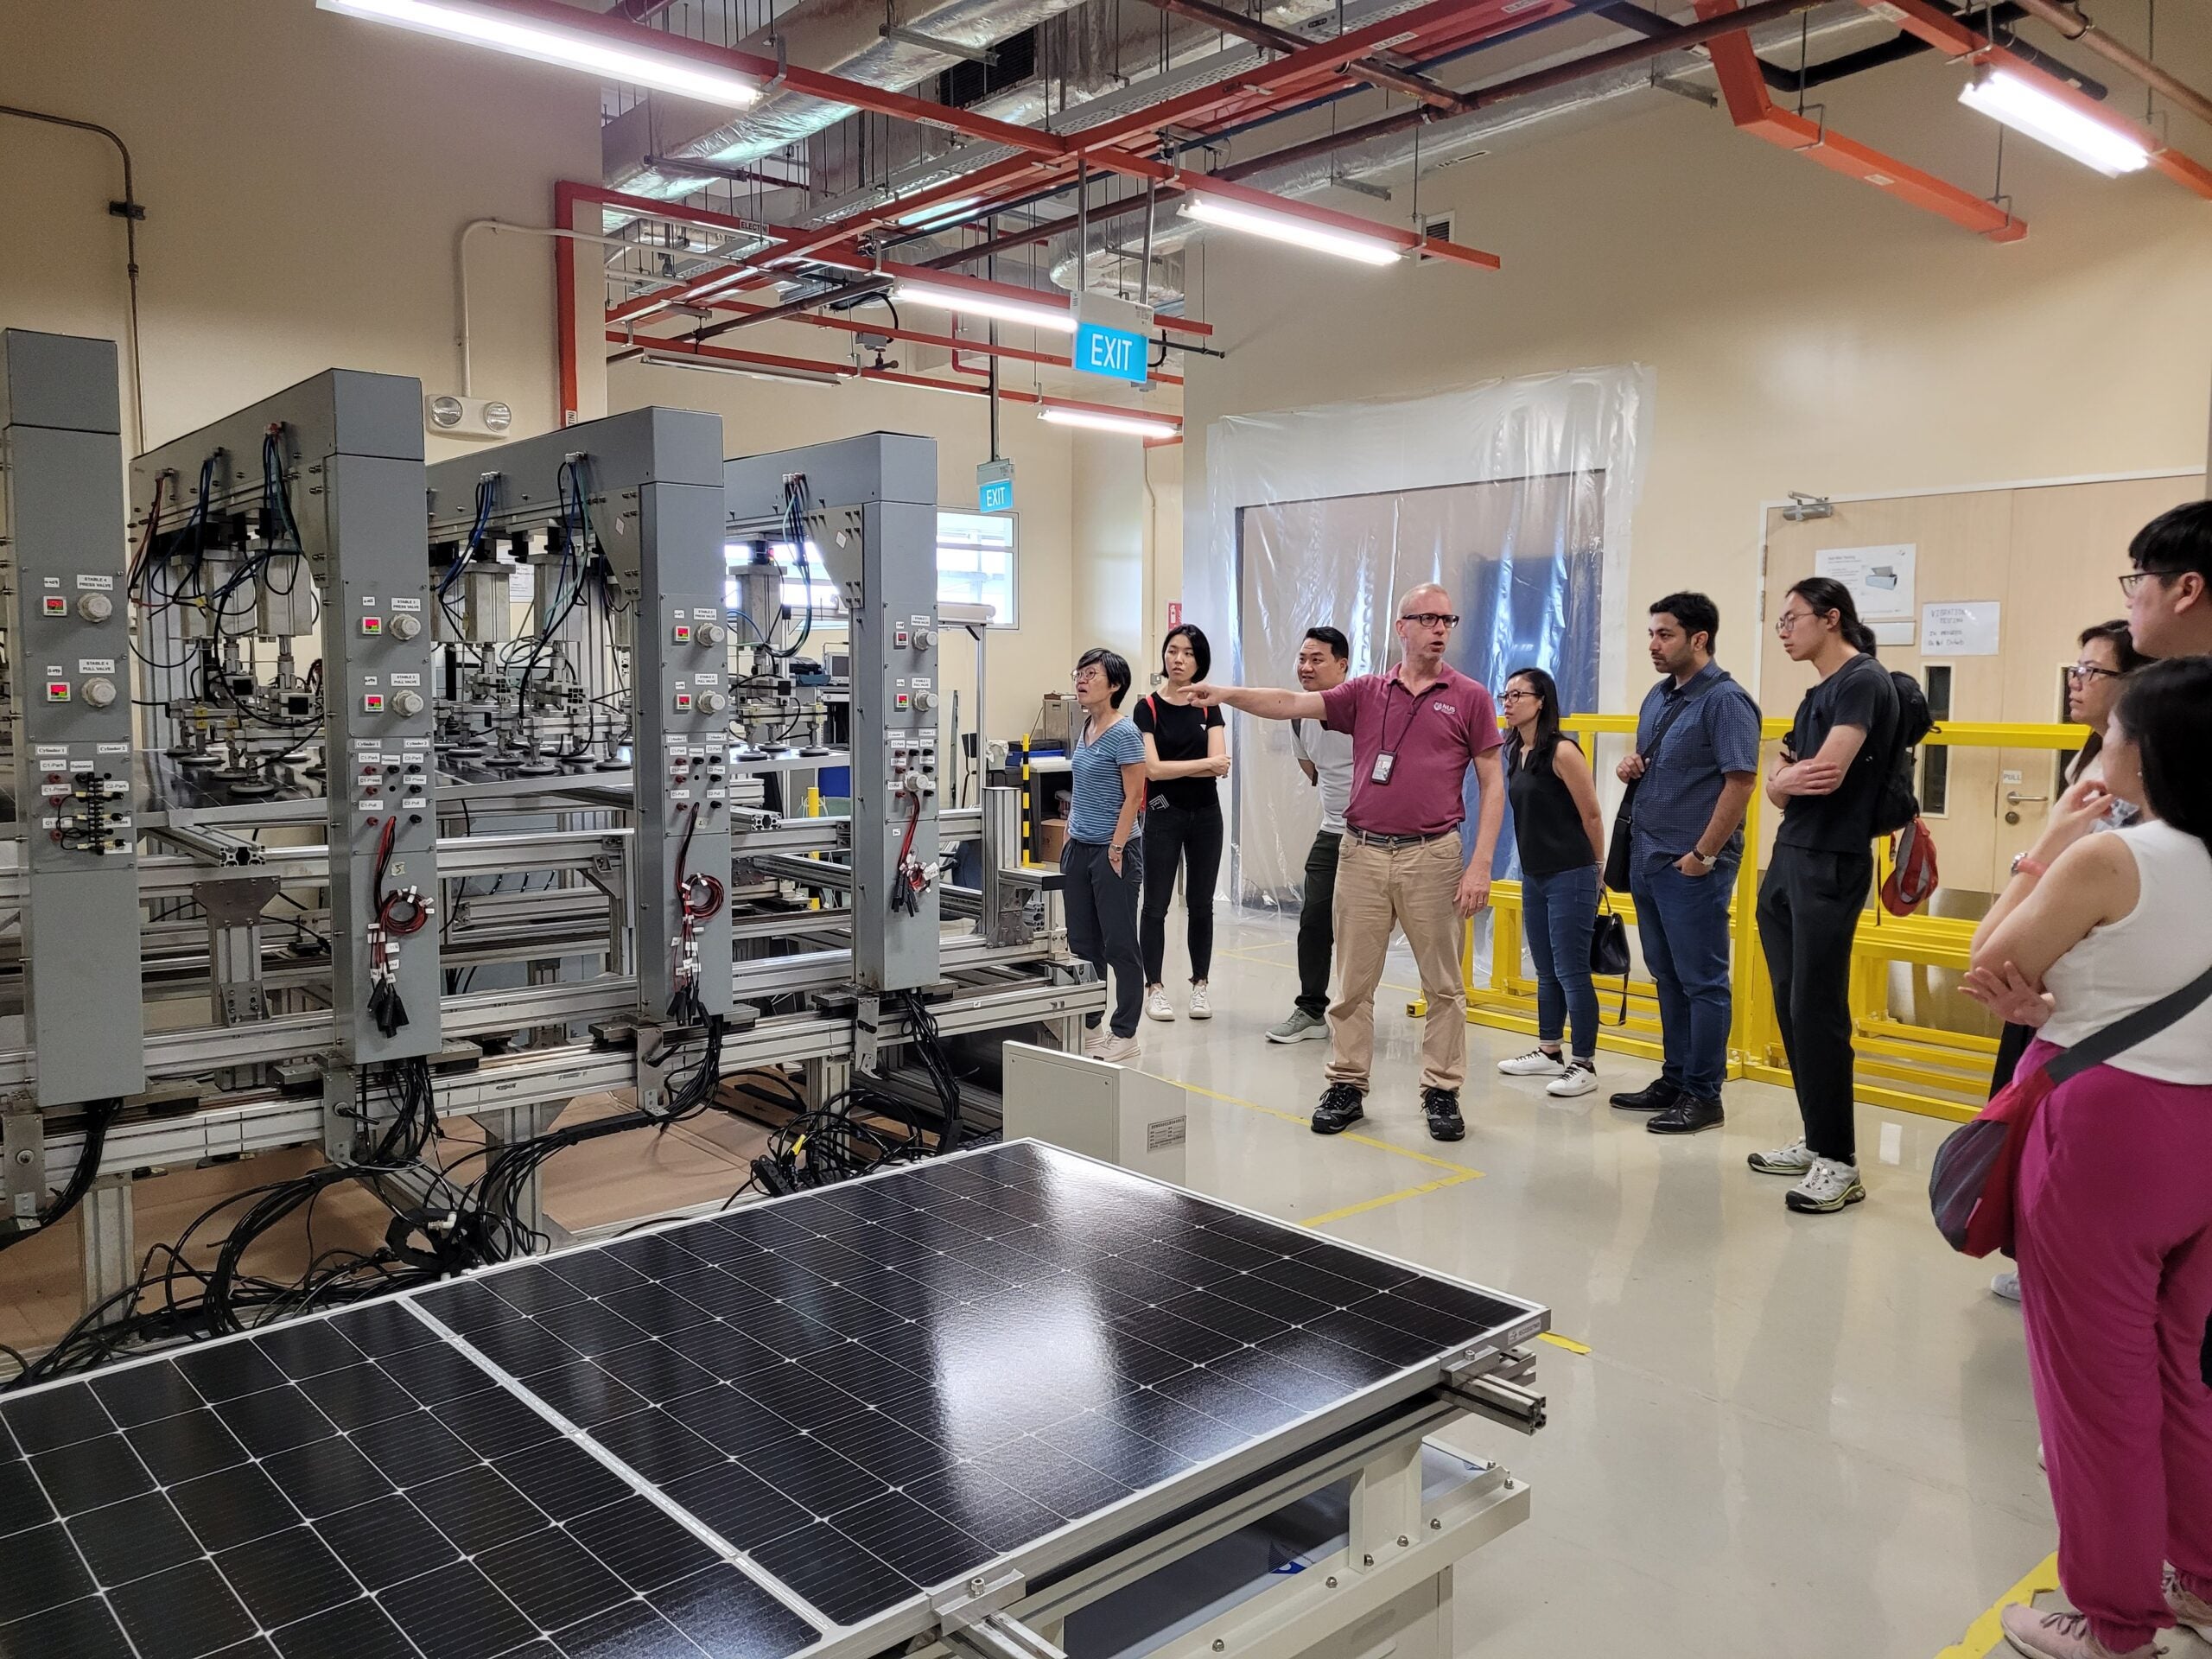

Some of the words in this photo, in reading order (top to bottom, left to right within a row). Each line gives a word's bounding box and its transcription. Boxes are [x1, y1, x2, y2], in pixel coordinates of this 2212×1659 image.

[1090, 333, 1133, 372] EXIT
[986, 486, 1006, 507] EXIT
[1443, 703, 1456, 713] NUS
